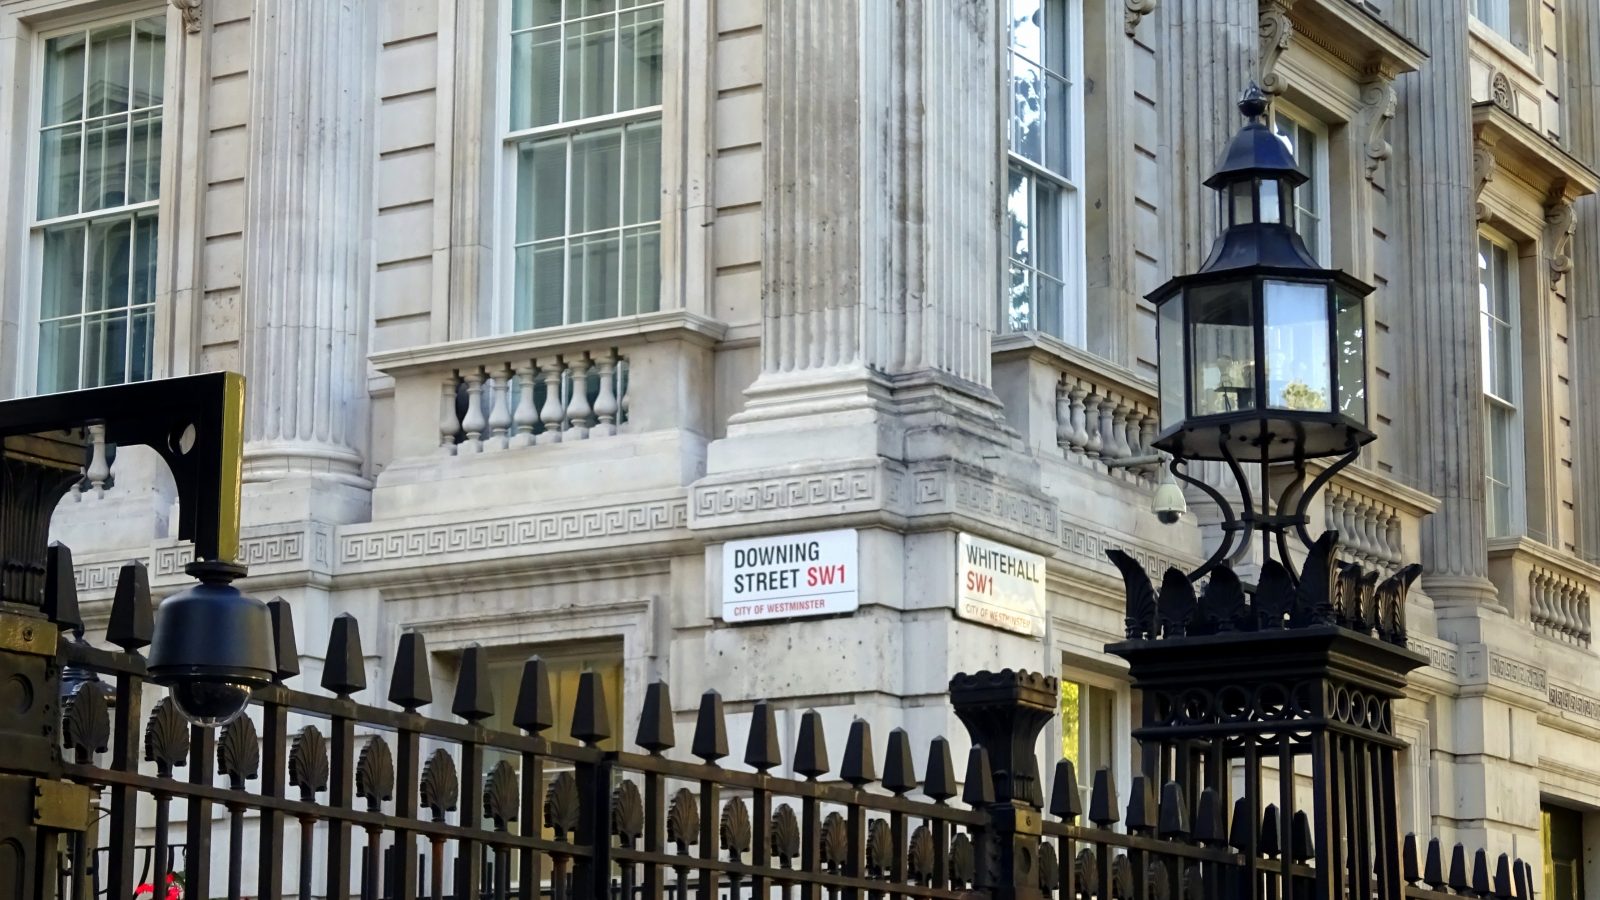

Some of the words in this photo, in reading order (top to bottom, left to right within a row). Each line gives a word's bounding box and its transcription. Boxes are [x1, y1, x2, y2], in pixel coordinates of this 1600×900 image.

[734, 541, 820, 568] DOWNING
[966, 544, 1039, 583] WHITEHALL
[734, 568, 800, 594] STREET
[807, 564, 845, 587] SW1
[966, 570, 993, 596] SW1
[734, 606, 752, 617] CITY
[754, 604, 765, 615] OF
[767, 599, 825, 613] WESTMINSTER
[965, 603, 979, 615] CITY
[980, 607, 989, 617] OF
